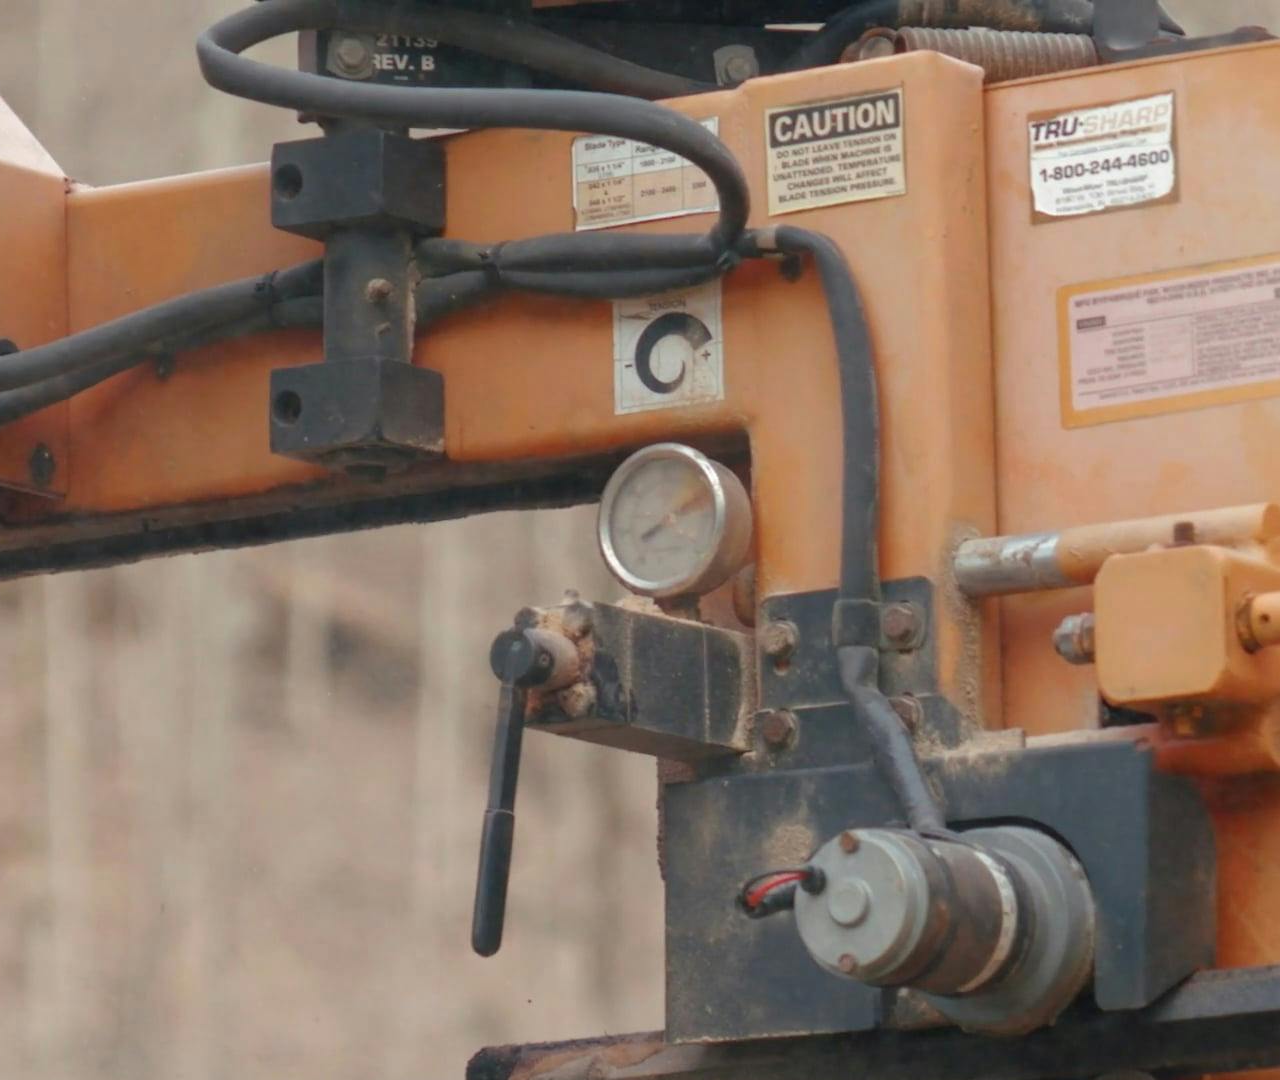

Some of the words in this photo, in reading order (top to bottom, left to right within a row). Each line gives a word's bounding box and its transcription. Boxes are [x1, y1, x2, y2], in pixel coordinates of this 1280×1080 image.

[373, 54, 415, 70] REV.
[421, 55, 435, 71] B
[774, 98, 895, 142] CAUTION
[776, 150, 789, 159] DO
[792, 147, 809, 156] NOT
[812, 142, 840, 153] LEAVE
[843, 134, 881, 148] TENSION
[883, 132, 897, 142] ON
[781, 157, 809, 169] BLADE
[812, 154, 838, 165] WHEN
[841, 147, 882, 162] MACHINE
[884, 144, 892, 153] IS
[837, 154, 901, 170] TEMPERATURE
[1039, 150, 1170, 183] 1-800-244-4600
[787, 177, 830, 191] CHANGES
[832, 173, 853, 184] WILL
[855, 167, 888, 179] AFFECT
[778, 191, 806, 203] BLADE
[809, 186, 847, 199] TENSION
